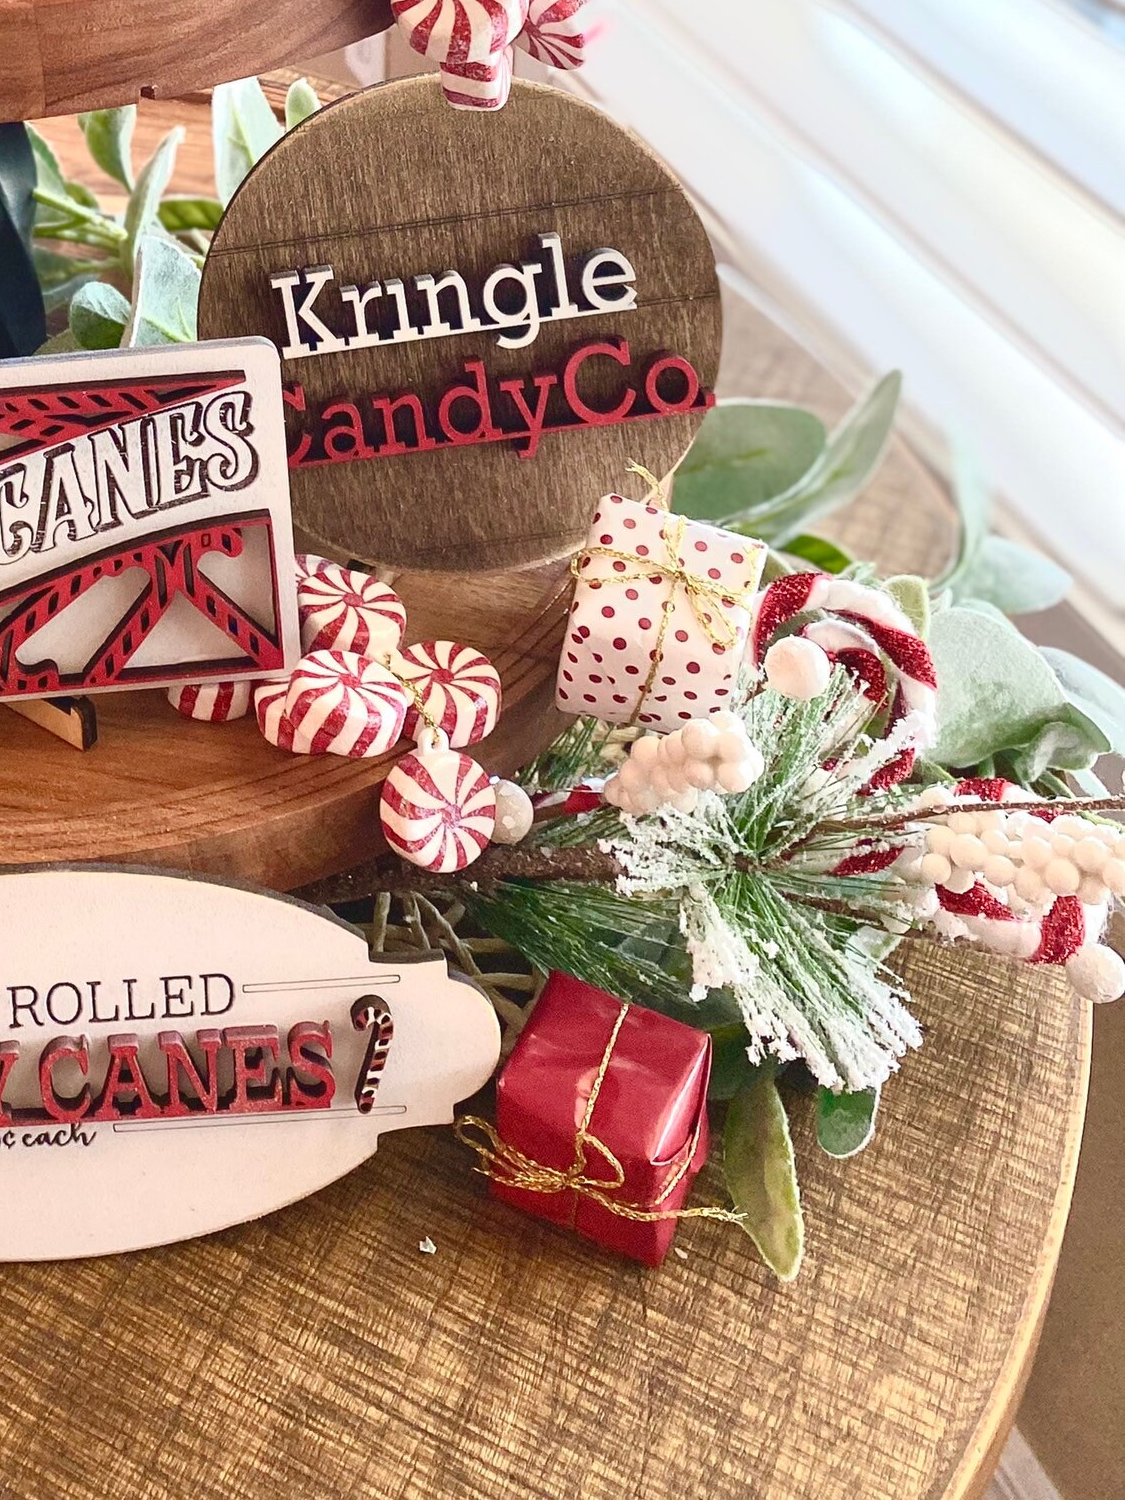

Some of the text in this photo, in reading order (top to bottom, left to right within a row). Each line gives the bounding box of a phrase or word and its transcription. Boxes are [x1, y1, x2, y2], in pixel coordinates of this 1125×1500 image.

[270, 232, 639, 360] Kringle
[7, 973, 236, 1030] ROLLED
[38, 1019, 337, 1124] CANES
[21, 1124, 97, 1148] each
